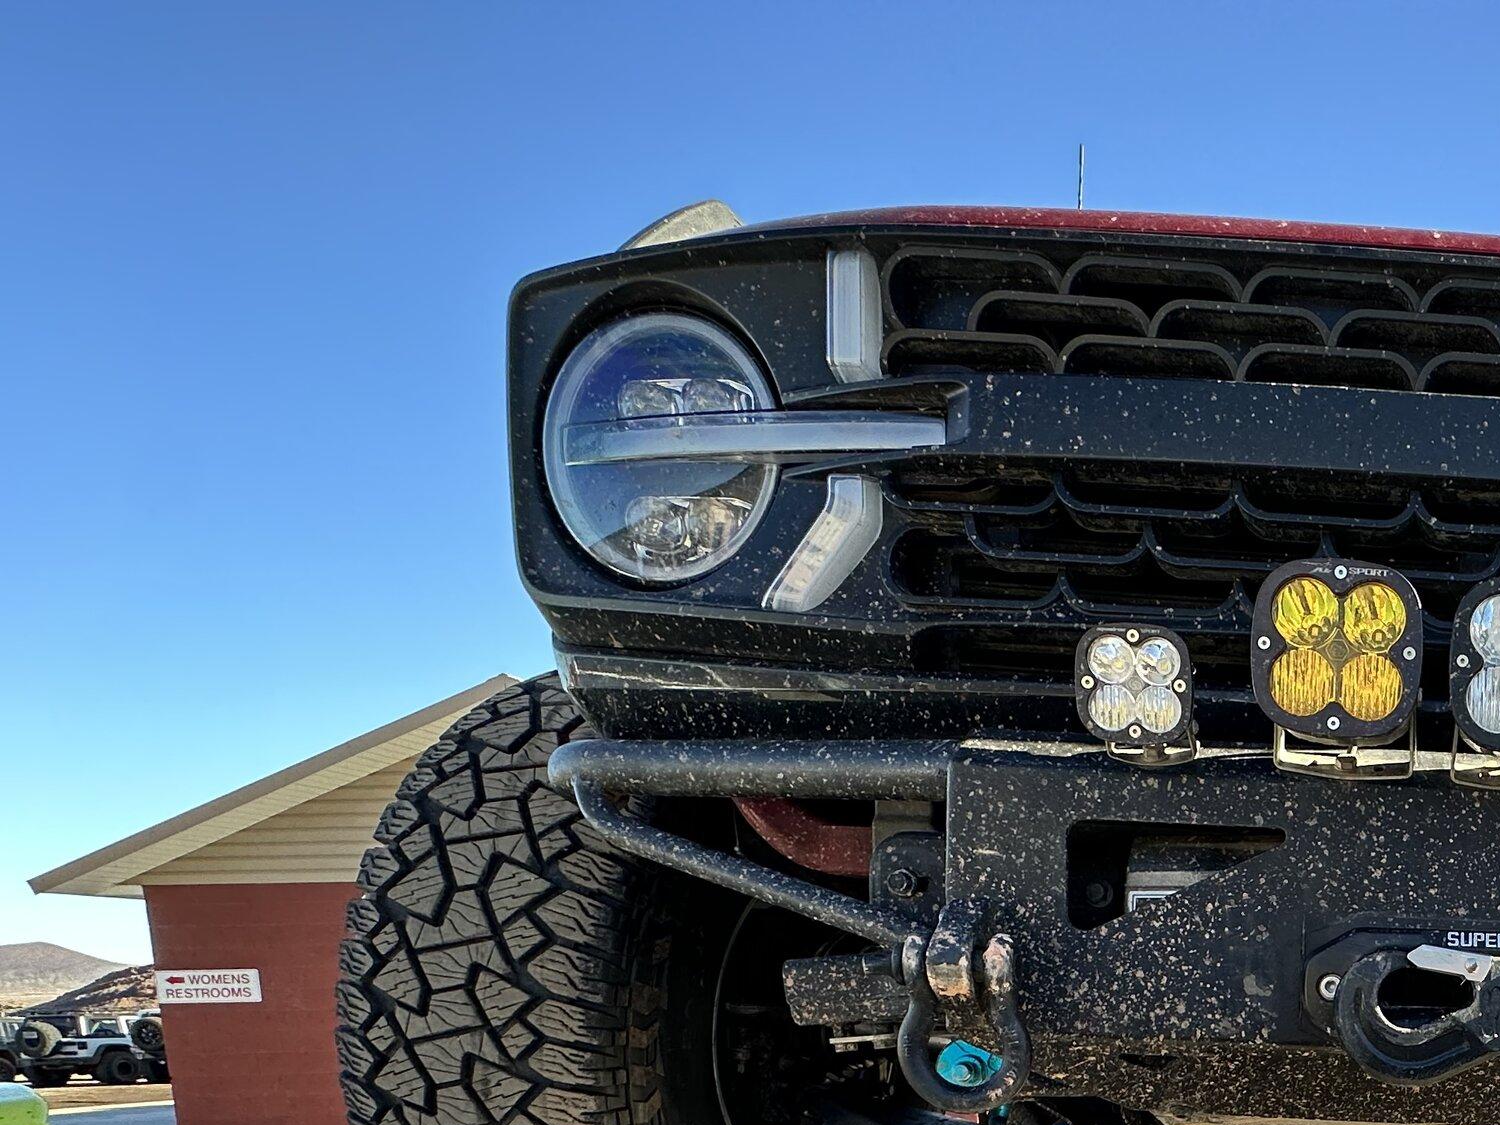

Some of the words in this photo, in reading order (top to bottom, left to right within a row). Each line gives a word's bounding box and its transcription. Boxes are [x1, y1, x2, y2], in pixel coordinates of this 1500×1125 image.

[1348, 566, 1389, 577] SPORT
[187, 973, 250, 985] WOMENS
[166, 987, 252, 999] RESTROOMS
